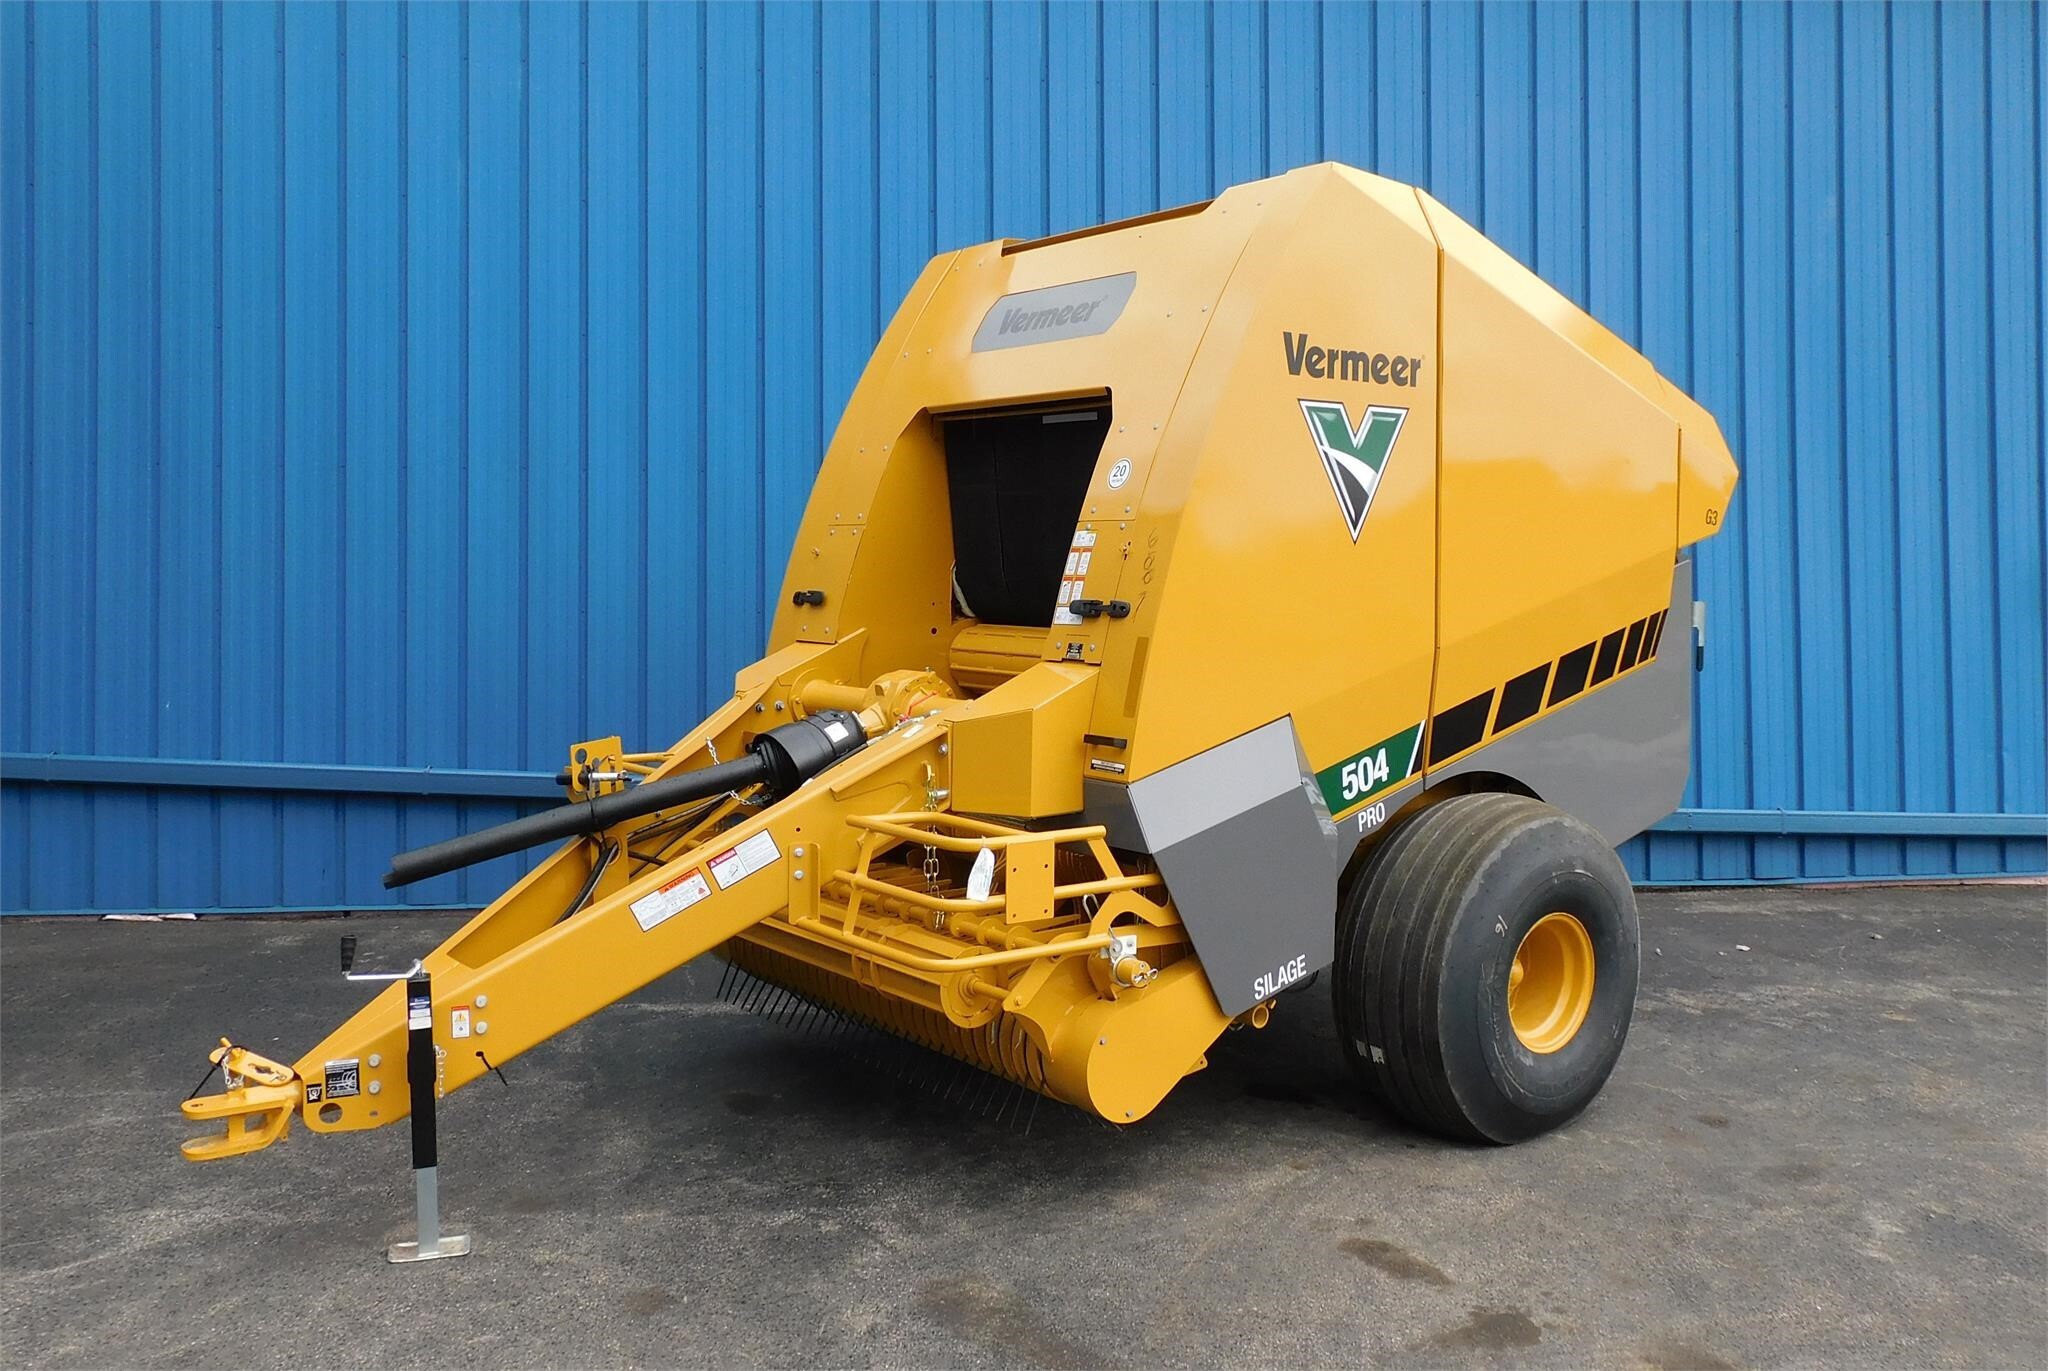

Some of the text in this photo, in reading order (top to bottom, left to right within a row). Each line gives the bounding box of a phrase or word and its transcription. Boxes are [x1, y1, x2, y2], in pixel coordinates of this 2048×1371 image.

[999, 301, 1101, 336] Vermeer
[1283, 331, 1421, 388] Vermeer
[1113, 464, 1127, 478] 20
[1705, 508, 1718, 526] G3
[1341, 747, 1390, 801] 504
[1358, 801, 1386, 833] PRO
[1253, 954, 1307, 1001] SILAGE
